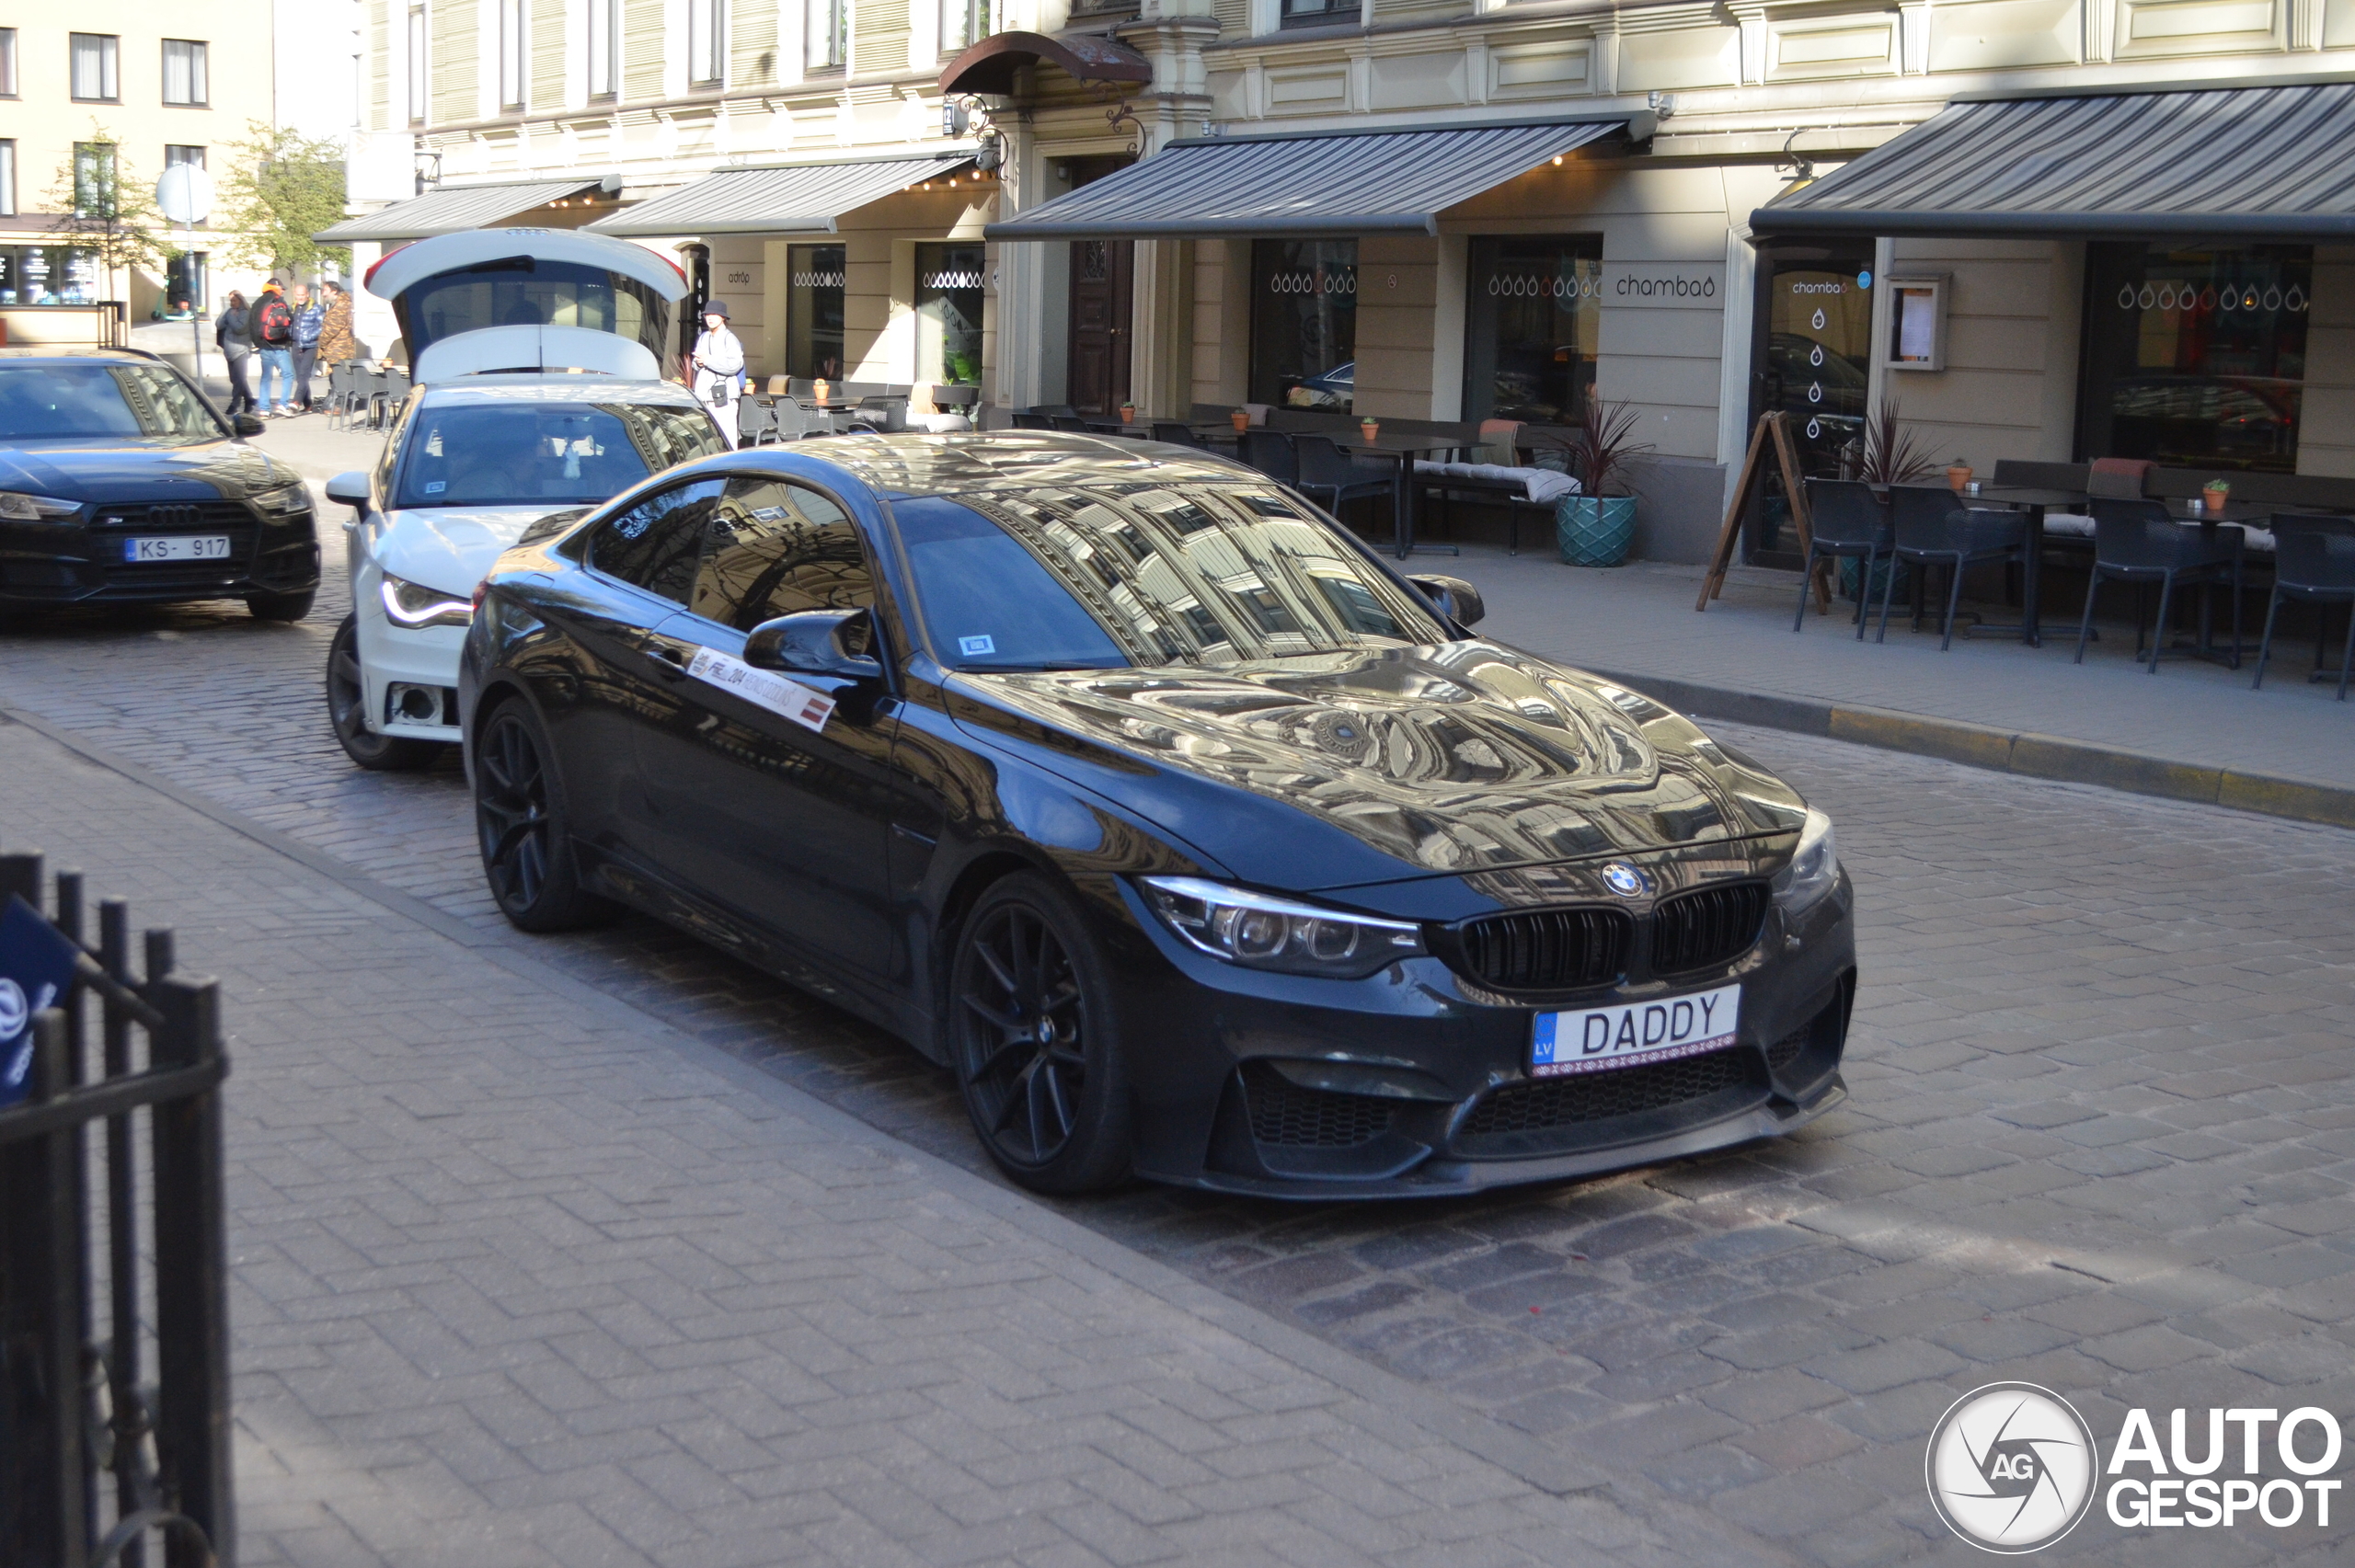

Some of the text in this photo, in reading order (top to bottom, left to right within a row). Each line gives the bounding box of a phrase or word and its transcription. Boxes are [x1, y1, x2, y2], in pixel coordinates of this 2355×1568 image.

[1616, 274, 1716, 297] chambao
[1793, 281, 1848, 294] chambao
[193, 538, 226, 556] 917
[728, 667, 747, 687] 204
[1582, 993, 1719, 1055] DADDY
[1535, 1042, 1553, 1057] LV
